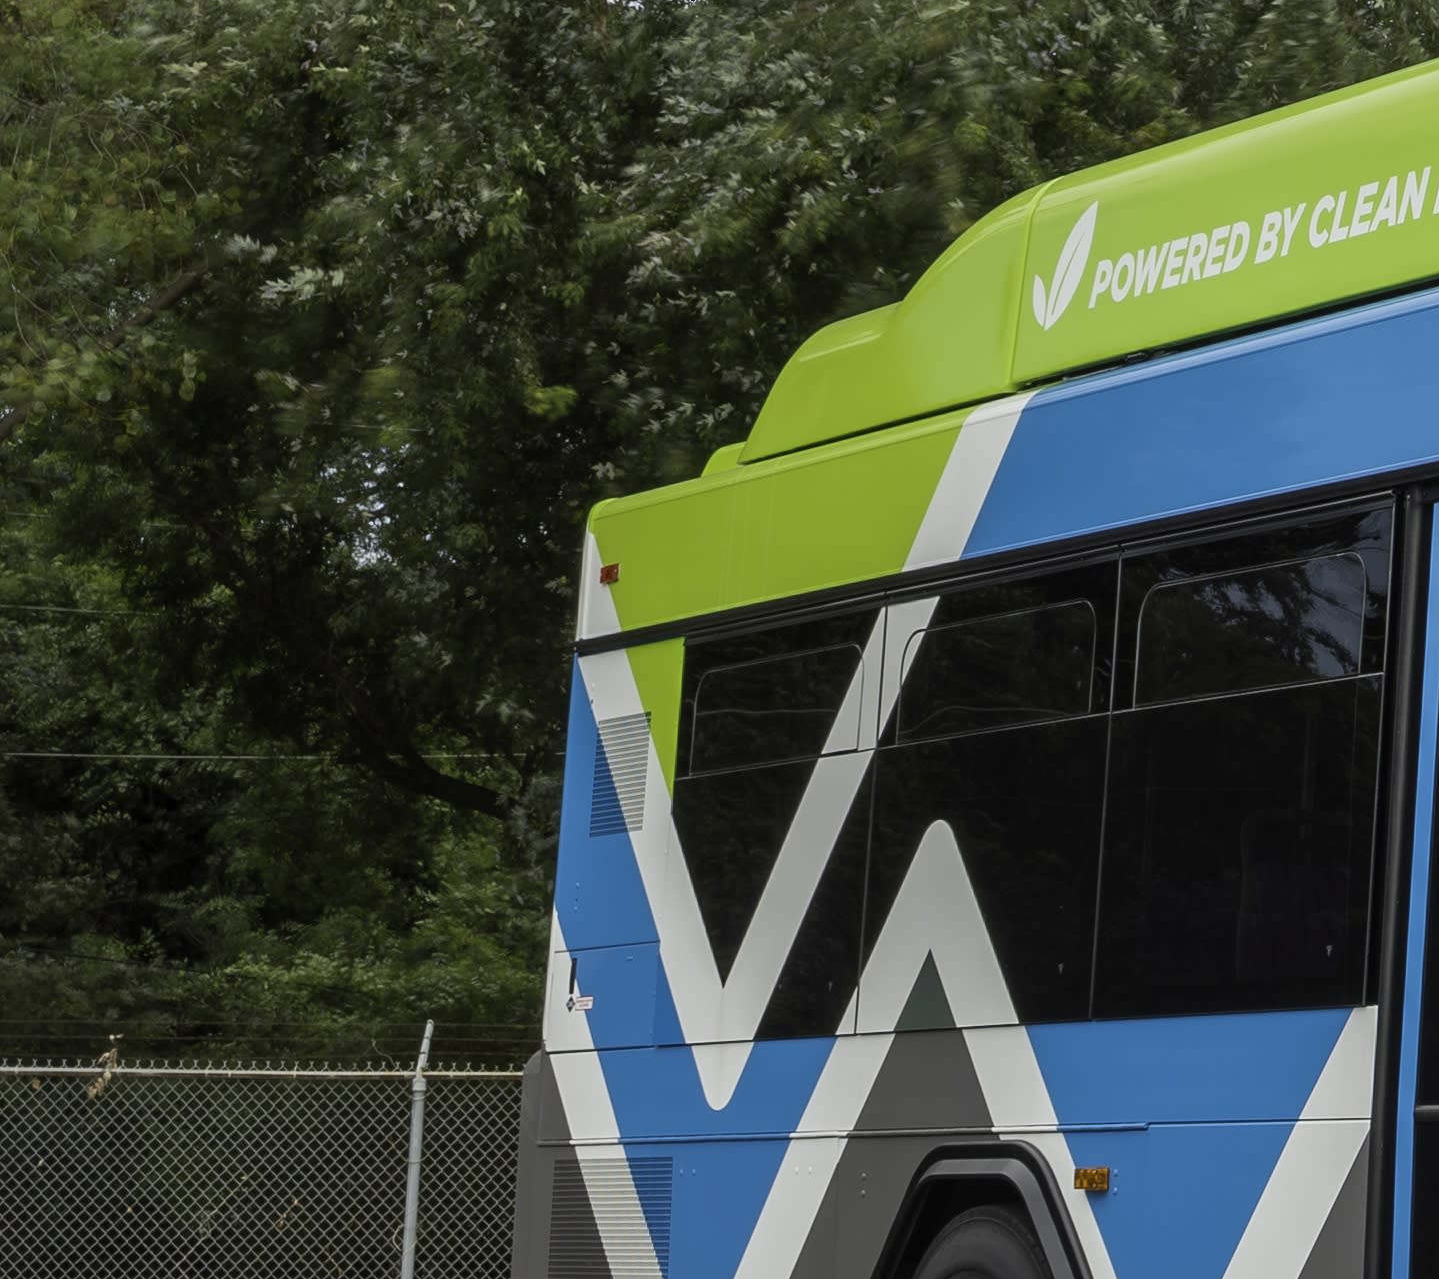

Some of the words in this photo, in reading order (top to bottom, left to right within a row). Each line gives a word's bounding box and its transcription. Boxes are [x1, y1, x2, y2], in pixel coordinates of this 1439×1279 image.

[1088, 221, 1251, 309] POWERED
[1254, 203, 1307, 265] BY
[1308, 166, 1432, 249] CLEAN
